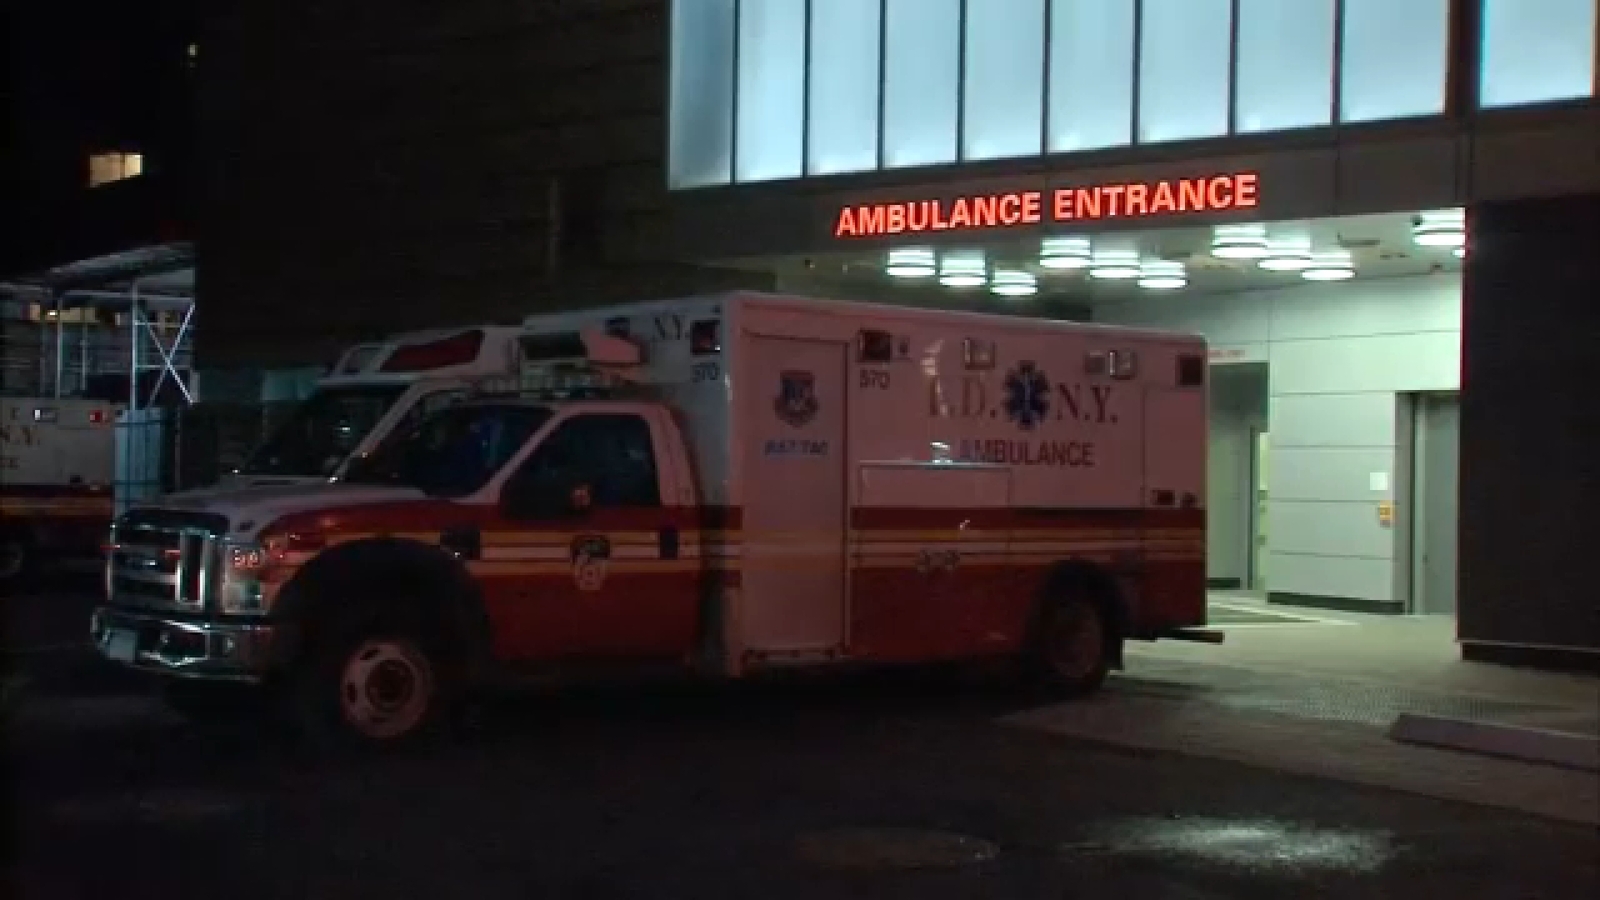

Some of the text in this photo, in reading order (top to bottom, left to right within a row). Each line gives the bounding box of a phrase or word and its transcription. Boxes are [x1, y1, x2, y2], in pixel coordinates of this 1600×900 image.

[835, 173, 1258, 237] AMBULANCE ENTRANCE
[859, 369, 891, 390] 570
[1055, 383, 1118, 423] N.Y.
[958, 439, 1095, 466] AMBULANCE
